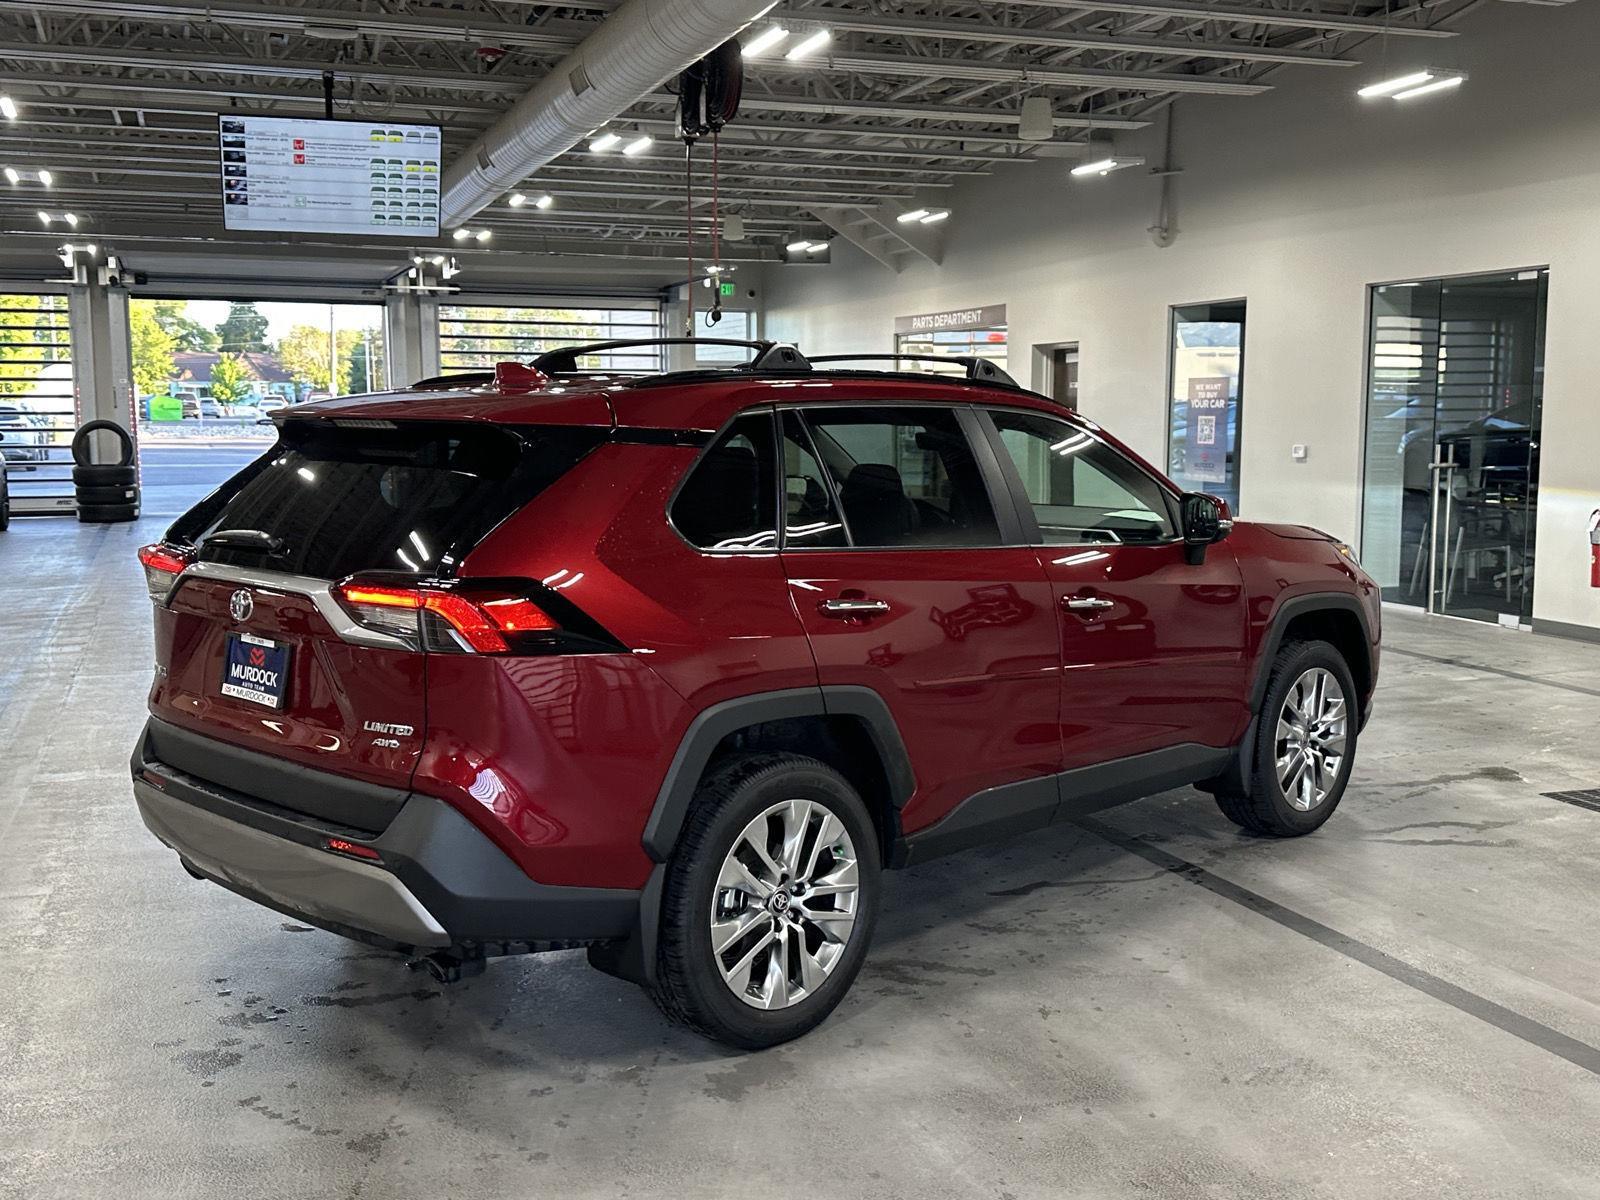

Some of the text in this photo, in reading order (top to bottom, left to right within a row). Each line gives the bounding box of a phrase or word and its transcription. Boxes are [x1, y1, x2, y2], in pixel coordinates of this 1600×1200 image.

[912, 310, 982, 329] PARTS DEPARTMENT
[1206, 391, 1218, 399] BUY
[1191, 399, 1225, 408] YOUR CAR
[231, 662, 278, 688] MURDOCK
[236, 689, 266, 702] MURDOCK
[363, 720, 414, 736] LIMITED
[371, 738, 400, 748] AWD
